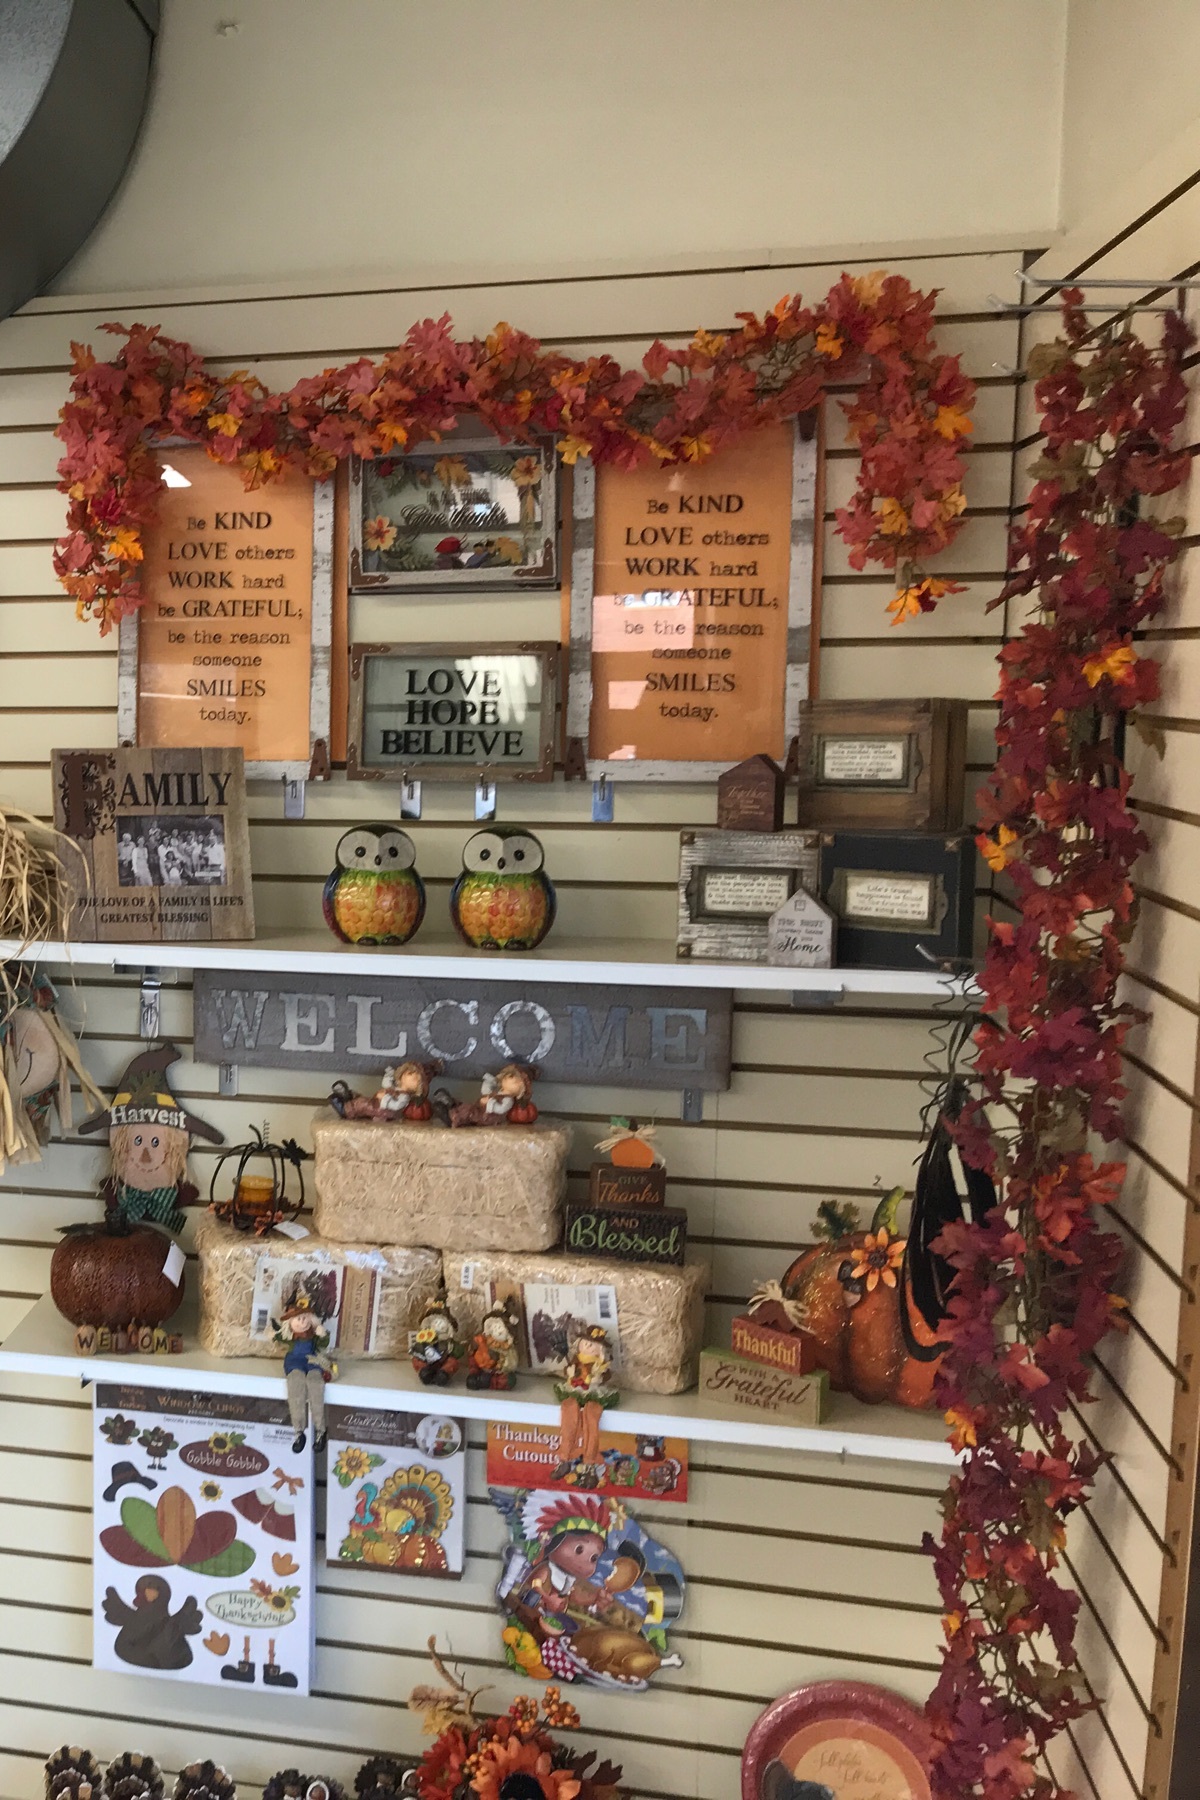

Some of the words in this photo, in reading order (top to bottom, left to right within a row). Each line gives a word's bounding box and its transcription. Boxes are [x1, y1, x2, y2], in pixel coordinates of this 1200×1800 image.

[647, 500, 668, 514] Be
[678, 494, 743, 514] KIND
[187, 517, 206, 531] Be
[214, 512, 272, 530] KIND
[625, 527, 693, 546] LOVE
[702, 530, 769, 546] others
[168, 543, 228, 560] LOVE
[235, 546, 295, 560] others
[625, 558, 700, 576] WORK
[709, 561, 758, 576] hard
[168, 571, 233, 588] WORK
[242, 574, 285, 588] hard
[613, 592, 634, 606] be
[157, 603, 175, 617] be
[624, 619, 644, 634] be
[654, 619, 686, 635] the
[695, 622, 764, 635] reason
[168, 630, 185, 643] be
[193, 630, 221, 643] the
[229, 631, 290, 644] reason
[193, 655, 262, 667] someone
[652, 646, 731, 659] someone
[186, 679, 266, 697] SMILES
[405, 669, 501, 697] LOVE
[645, 673, 736, 692] SMILES
[200, 706, 252, 723] today.
[404, 700, 500, 725] HOPE
[658, 703, 718, 722] today.
[380, 729, 524, 757] BELIEVE
[59, 753, 232, 839] FAMILY
[101, 896, 129, 907] LOVE
[132, 896, 146, 907] OF
[158, 896, 199, 908] FAMILY
[200, 896, 211, 907] IS
[100, 912, 155, 924] GREATEST
[158, 911, 210, 924] BLESSING
[210, 988, 709, 1070] WELCOME
[110, 1105, 187, 1129] Harvest
[599, 1182, 660, 1203] Thanks
[611, 1217, 639, 1228] AND
[569, 1213, 680, 1256] Blessed
[734, 1328, 797, 1366] Thankful
[706, 1361, 811, 1404] Grateful
[739, 1366, 767, 1380] WITH
[734, 1393, 780, 1410] HEART
[186, 1449, 221, 1467] Gobble
[226, 1455, 262, 1472] Gobble
[503, 1444, 561, 1465] Cutouts
[229, 1593, 262, 1609] Happy
[215, 1603, 286, 1624] Thanksgiving
